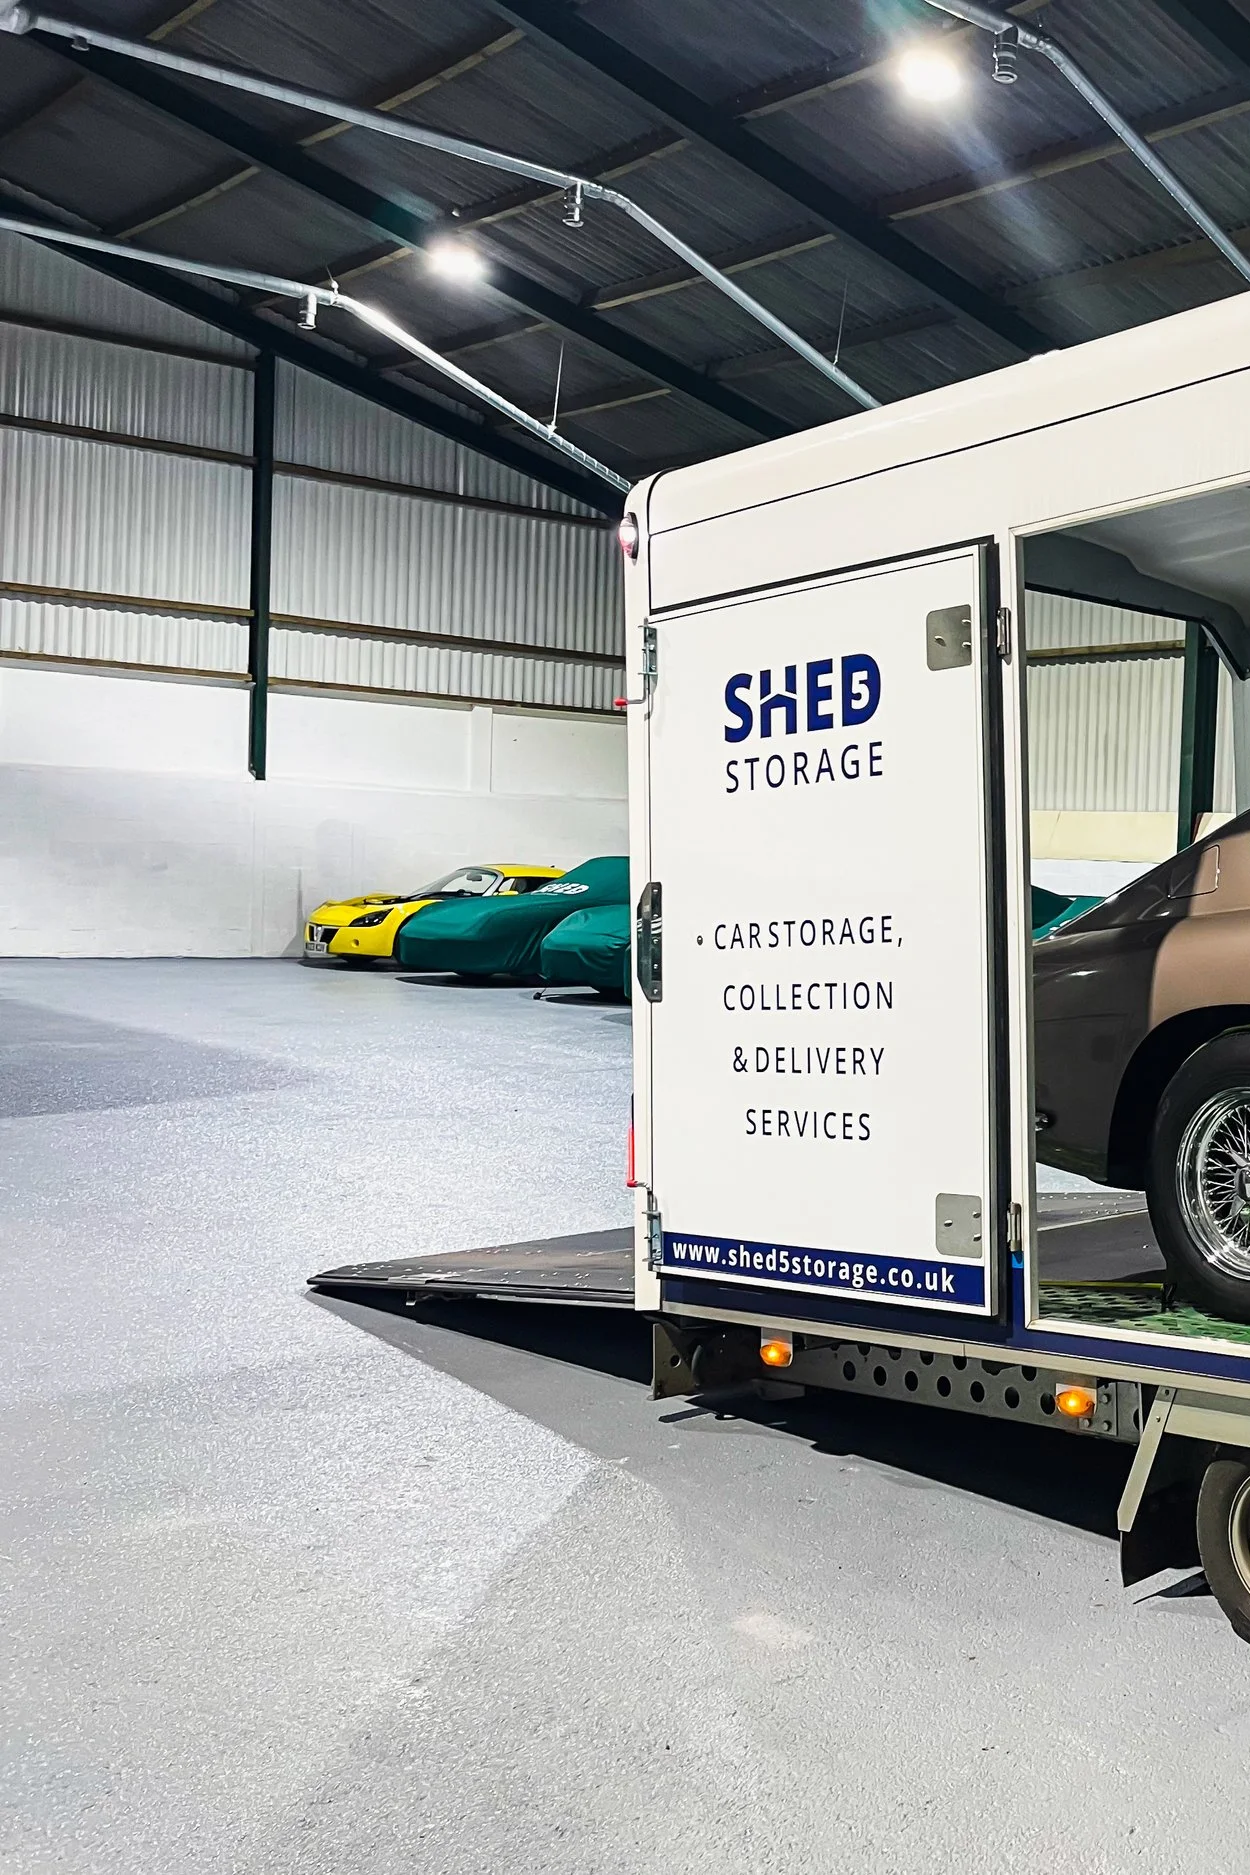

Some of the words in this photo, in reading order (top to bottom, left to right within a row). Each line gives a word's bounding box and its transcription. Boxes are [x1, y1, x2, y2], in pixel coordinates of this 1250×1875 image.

[725, 741, 884, 793] STORAGE
[723, 981, 893, 1011] COLLECTION
[745, 1108, 871, 1141] SERVICES
[672, 1240, 955, 1293] www.shed5storage.co.uk
